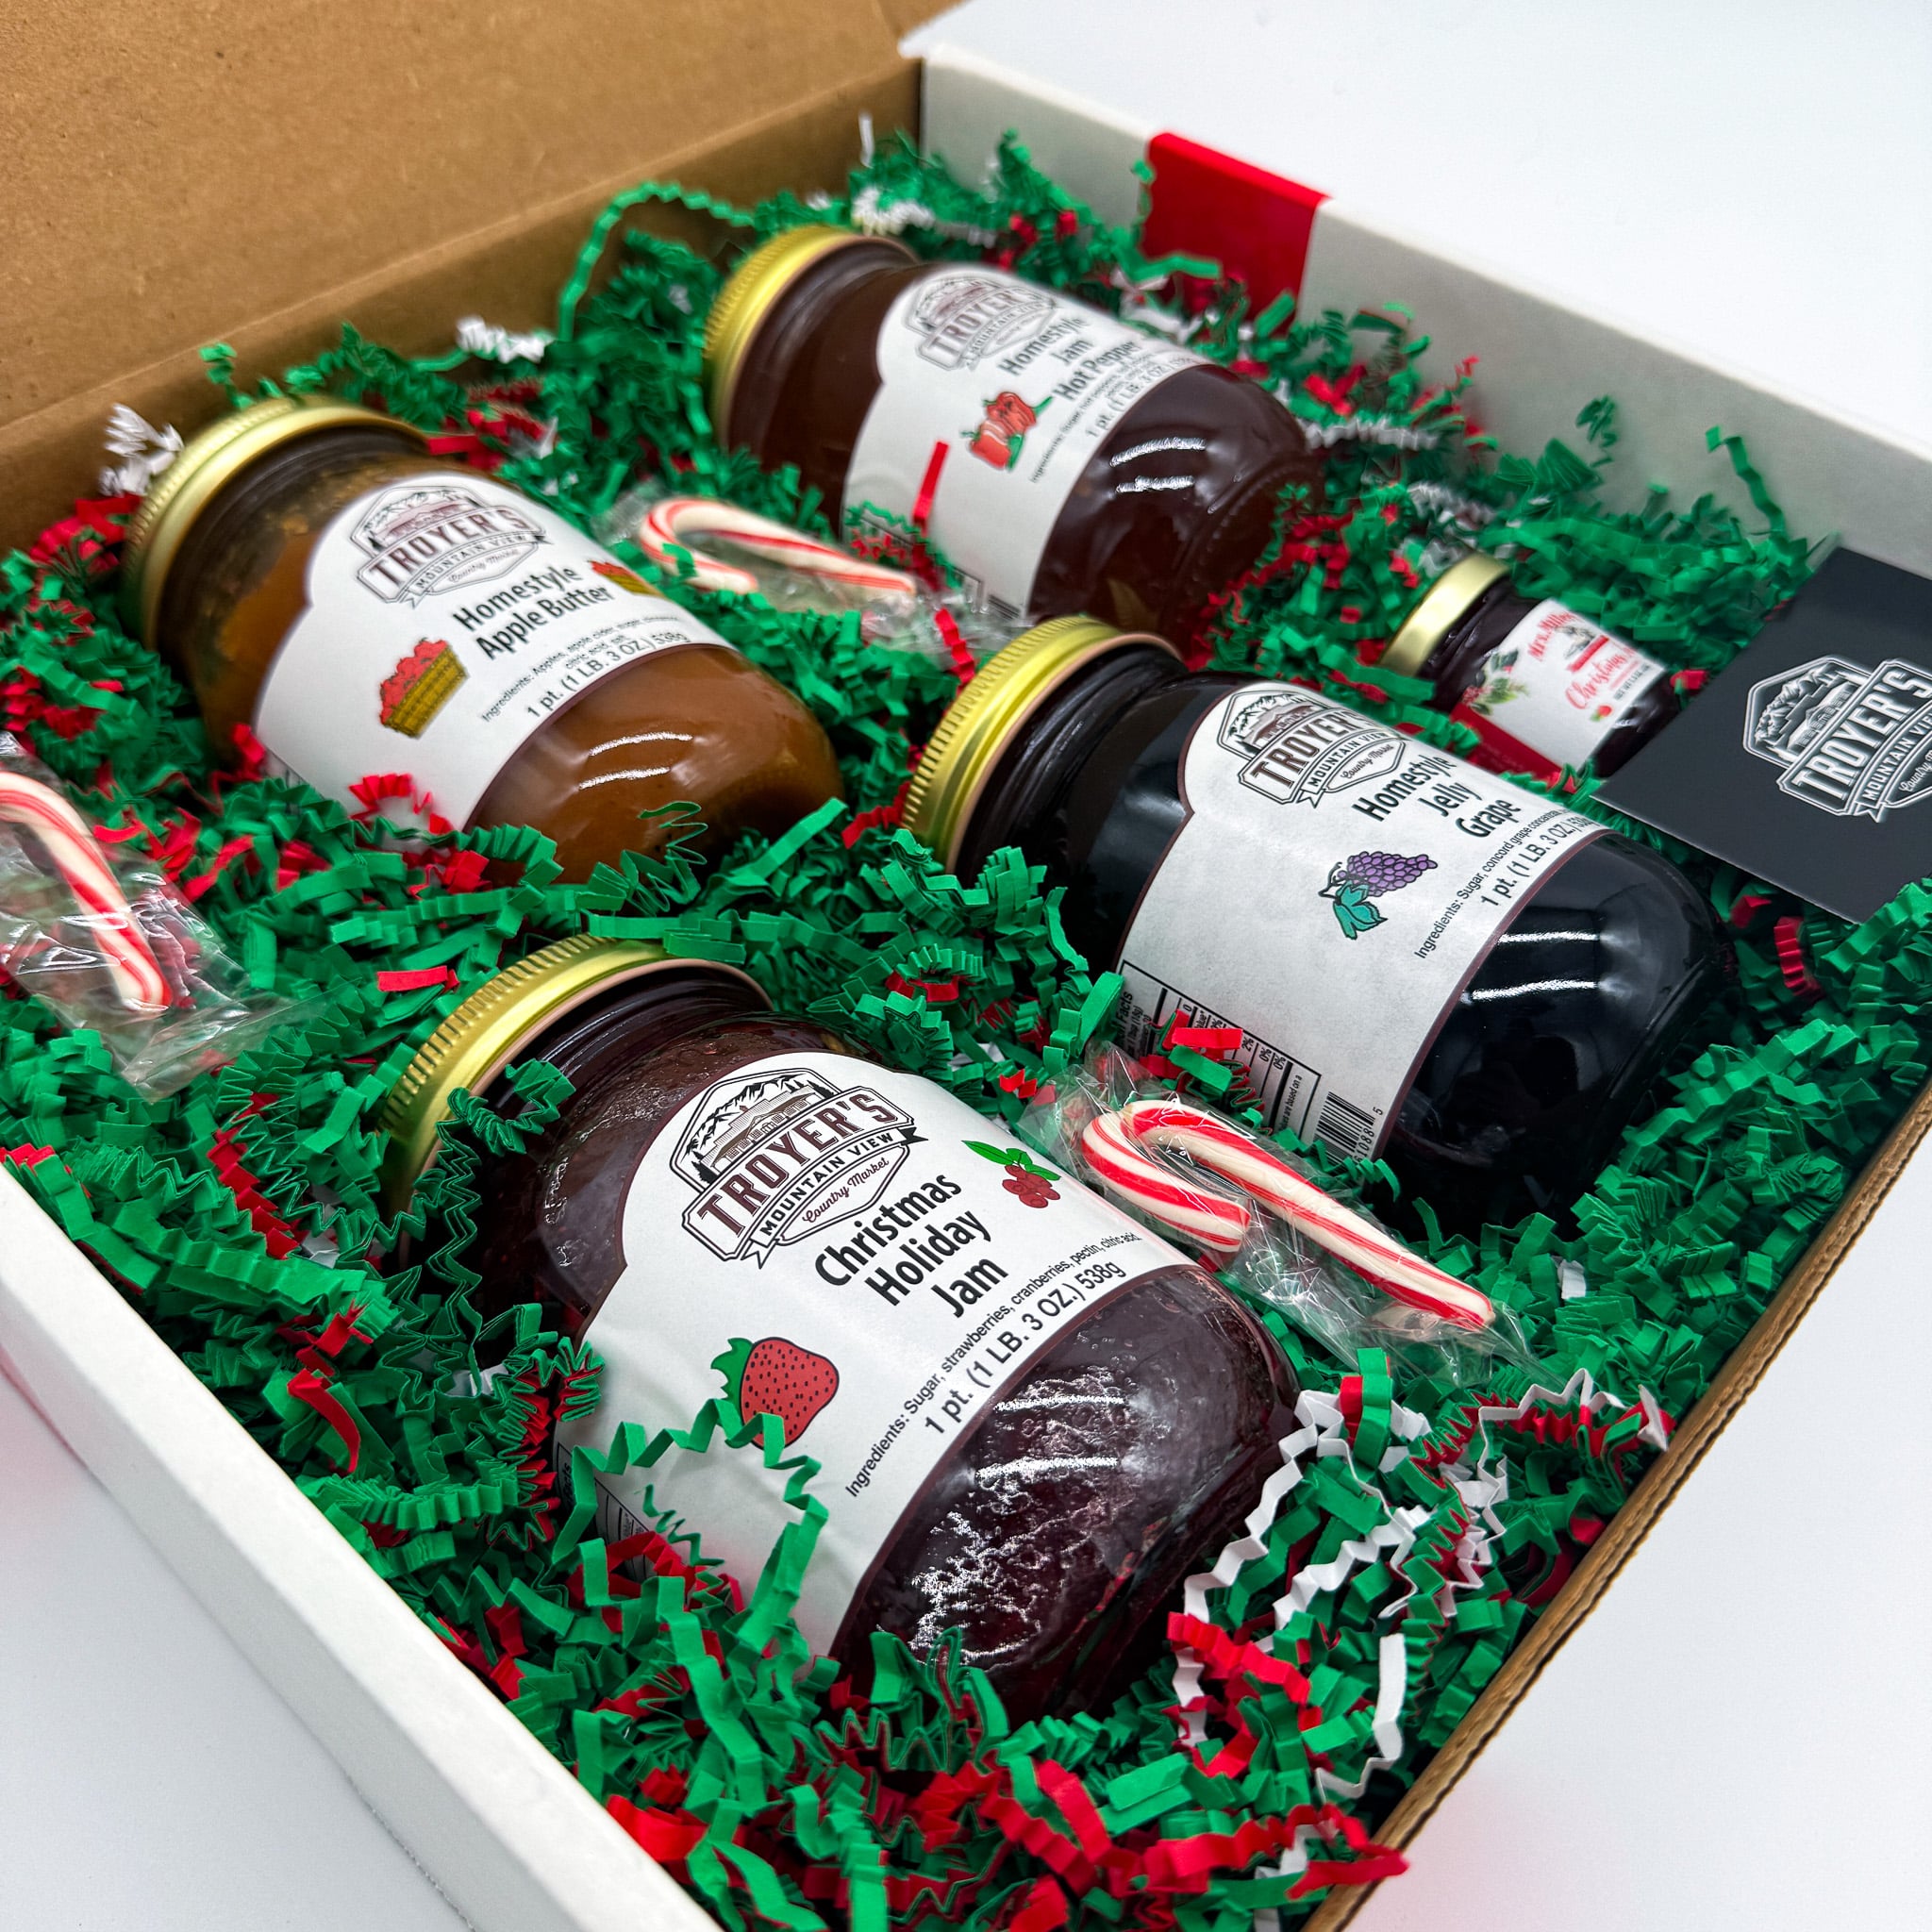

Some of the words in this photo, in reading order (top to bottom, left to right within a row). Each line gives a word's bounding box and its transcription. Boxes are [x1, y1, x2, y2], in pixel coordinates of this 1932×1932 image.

[927, 287, 1041, 357] TROYER'S
[998, 317, 1091, 375] Homestyle
[1051, 340, 1094, 366] Jam
[1053, 371, 1096, 402] Hot
[1081, 341, 1141, 375] Pepper
[1086, 428, 1099, 438] 1
[369, 509, 531, 587] TROYER'S
[415, 543, 486, 590] MOUNTAIN
[491, 534, 528, 548] VIEW
[452, 565, 582, 632] Homestyle
[476, 611, 548, 660] Apple
[537, 586, 615, 619] Butter
[481, 675, 535, 723] Ingredients:
[527, 707, 541, 718] 1
[540, 691, 564, 712] pt.
[560, 674, 579, 693] (1
[576, 659, 610, 678] LB.
[606, 650, 622, 662] 3
[1250, 709, 1378, 790] TROYER'S
[1307, 740, 1360, 788] MOUNTAIN
[1362, 731, 1392, 742] VIEW
[1791, 670, 1932, 801] TROYER'S
[1862, 736, 1917, 802] MOUNTAIN
[1908, 711, 1932, 736] VIE
[1341, 755, 1374, 780] Country
[1351, 754, 1457, 822] Homestyle
[1417, 782, 1483, 818] Jelly
[1456, 799, 1521, 838] Grape
[1518, 843, 1551, 864] LB.
[1540, 834, 1559, 845] 3
[1414, 898, 1464, 960] Ingredients:
[1457, 871, 1490, 901] Sugar,
[1481, 841, 1515, 874] concord
[1509, 824, 1533, 847] grape
[1492, 877, 1519, 899] pt.
[1507, 860, 1531, 878] (1
[1481, 894, 1499, 908] 1
[1182, 1003, 1193, 1013] 0
[1241, 1036, 1255, 1053] 2%
[1258, 1046, 1273, 1063] 0%
[1273, 1057, 1287, 1071] 0%
[1286, 1085, 1298, 1107] based
[1292, 1078, 1301, 1087] on
[1295, 1074, 1303, 1082] a
[1372, 1106, 1384, 1116] 5
[697, 1092, 899, 1239] TROYER'S
[759, 1155, 846, 1237] MOUNTAIN
[848, 1132, 895, 1158] VIEW
[802, 1185, 851, 1224] Country
[845, 1157, 890, 1188] Market
[815, 1174, 962, 1287] Christmas
[864, 1210, 991, 1307] Holiday
[930, 1258, 1009, 1319] Jam
[844, 1412, 911, 1498] Ingredients:
[903, 1371, 948, 1416] Sugar,
[941, 1301, 1016, 1374] strawberries,
[1010, 1259, 1074, 1307] cranberries,
[1069, 1244, 1107, 1266] pectin,
[925, 1415, 945, 1436] 1
[941, 1383, 974, 1424] pt.
[966, 1359, 994, 1390] (1
[986, 1330, 1030, 1366] LB.
[1022, 1312, 1044, 1332] 3
[1037, 1281, 1087, 1318] OZ.)
[1074, 1261, 1127, 1291] 538g
